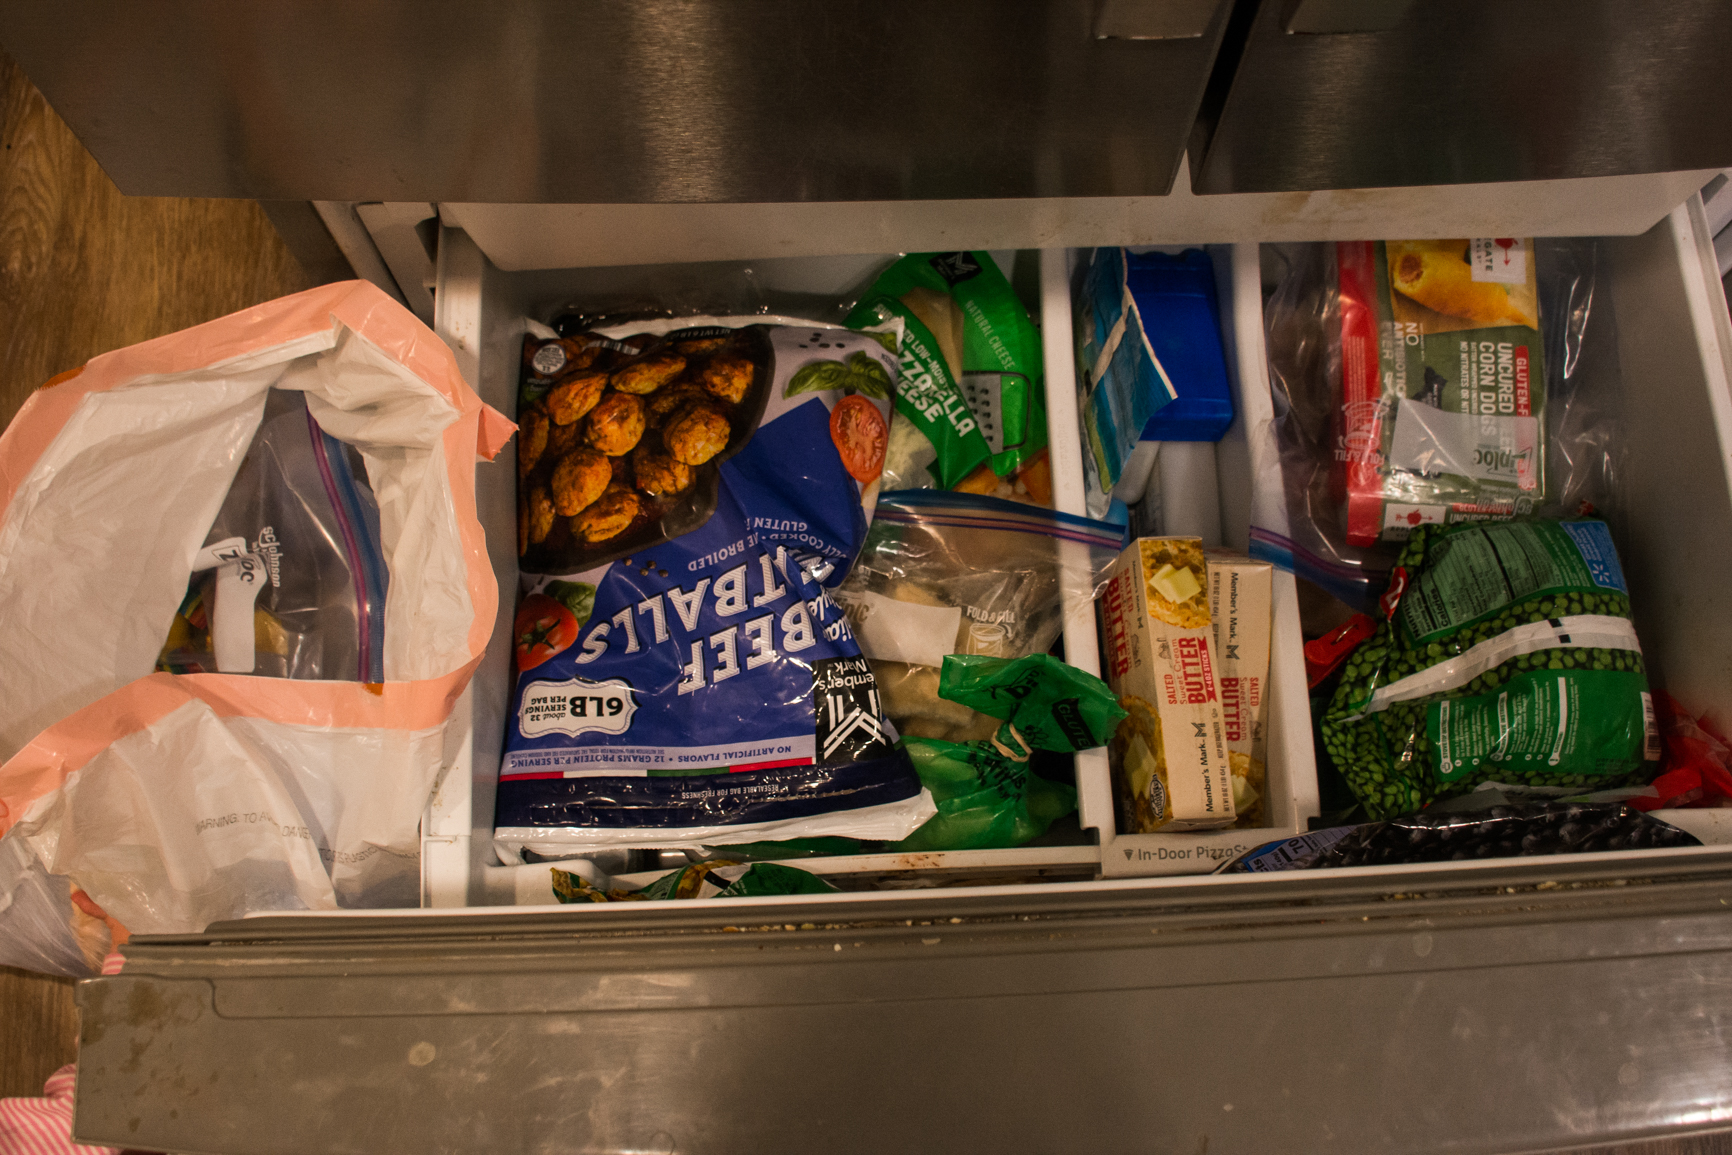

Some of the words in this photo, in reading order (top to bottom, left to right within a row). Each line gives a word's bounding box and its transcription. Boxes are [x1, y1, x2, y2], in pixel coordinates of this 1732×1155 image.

[965, 300, 994, 337] NATURAL
[988, 336, 1016, 370] CHEESE
[1406, 322, 1420, 346] NO
[1479, 341, 1496, 387] CORN
[1497, 342, 1515, 413] UNCURED
[1515, 357, 1531, 417] GLUTEN-F
[897, 377, 943, 423] EESE
[1480, 389, 1496, 436] DOGS
[754, 517, 808, 532] GLUTEN
[688, 538, 746, 572] BROILED
[1229, 572, 1238, 616] Member's
[966, 606, 988, 623] FOLD
[988, 612, 996, 622] &
[1428, 587, 1449, 627] Calories
[1107, 576, 1129, 676] BUTTER
[677, 601, 816, 696] BEEF
[1172, 638, 1182, 673] Cream
[834, 658, 868, 674] Mark
[1200, 650, 1211, 668] STICKS
[1178, 636, 1207, 704] BUTTER
[818, 672, 876, 691] ember's
[1164, 674, 1178, 704] SALTED
[1176, 676, 1188, 704] Sweet
[1250, 677, 1260, 707] SALTED
[525, 704, 567, 715] SERVINGS
[569, 696, 624, 718] 6LB
[1220, 677, 1241, 742] BUTTER
[530, 714, 540, 722] 32
[542, 713, 566, 722] about
[1058, 704, 1094, 750] GLUTE
[574, 754, 615, 764] PROTEIN
[618, 754, 651, 763] GRAMS
[654, 755, 664, 763] 12
[678, 752, 720, 762] FLAVORS
[722, 746, 775, 760] ARTIFICIAL
[780, 745, 792, 753] NO
[511, 758, 552, 768] SERVING
[720, 787, 730, 796] FOR
[730, 786, 742, 794] BAG
[742, 784, 780, 794] RESEALABLE
[1202, 768, 1214, 812] Member's
[243, 812, 258, 824] TO
[1138, 847, 1192, 861] In-Door
[1196, 846, 1233, 861] Pizza
[1288, 836, 1301, 853] 70
